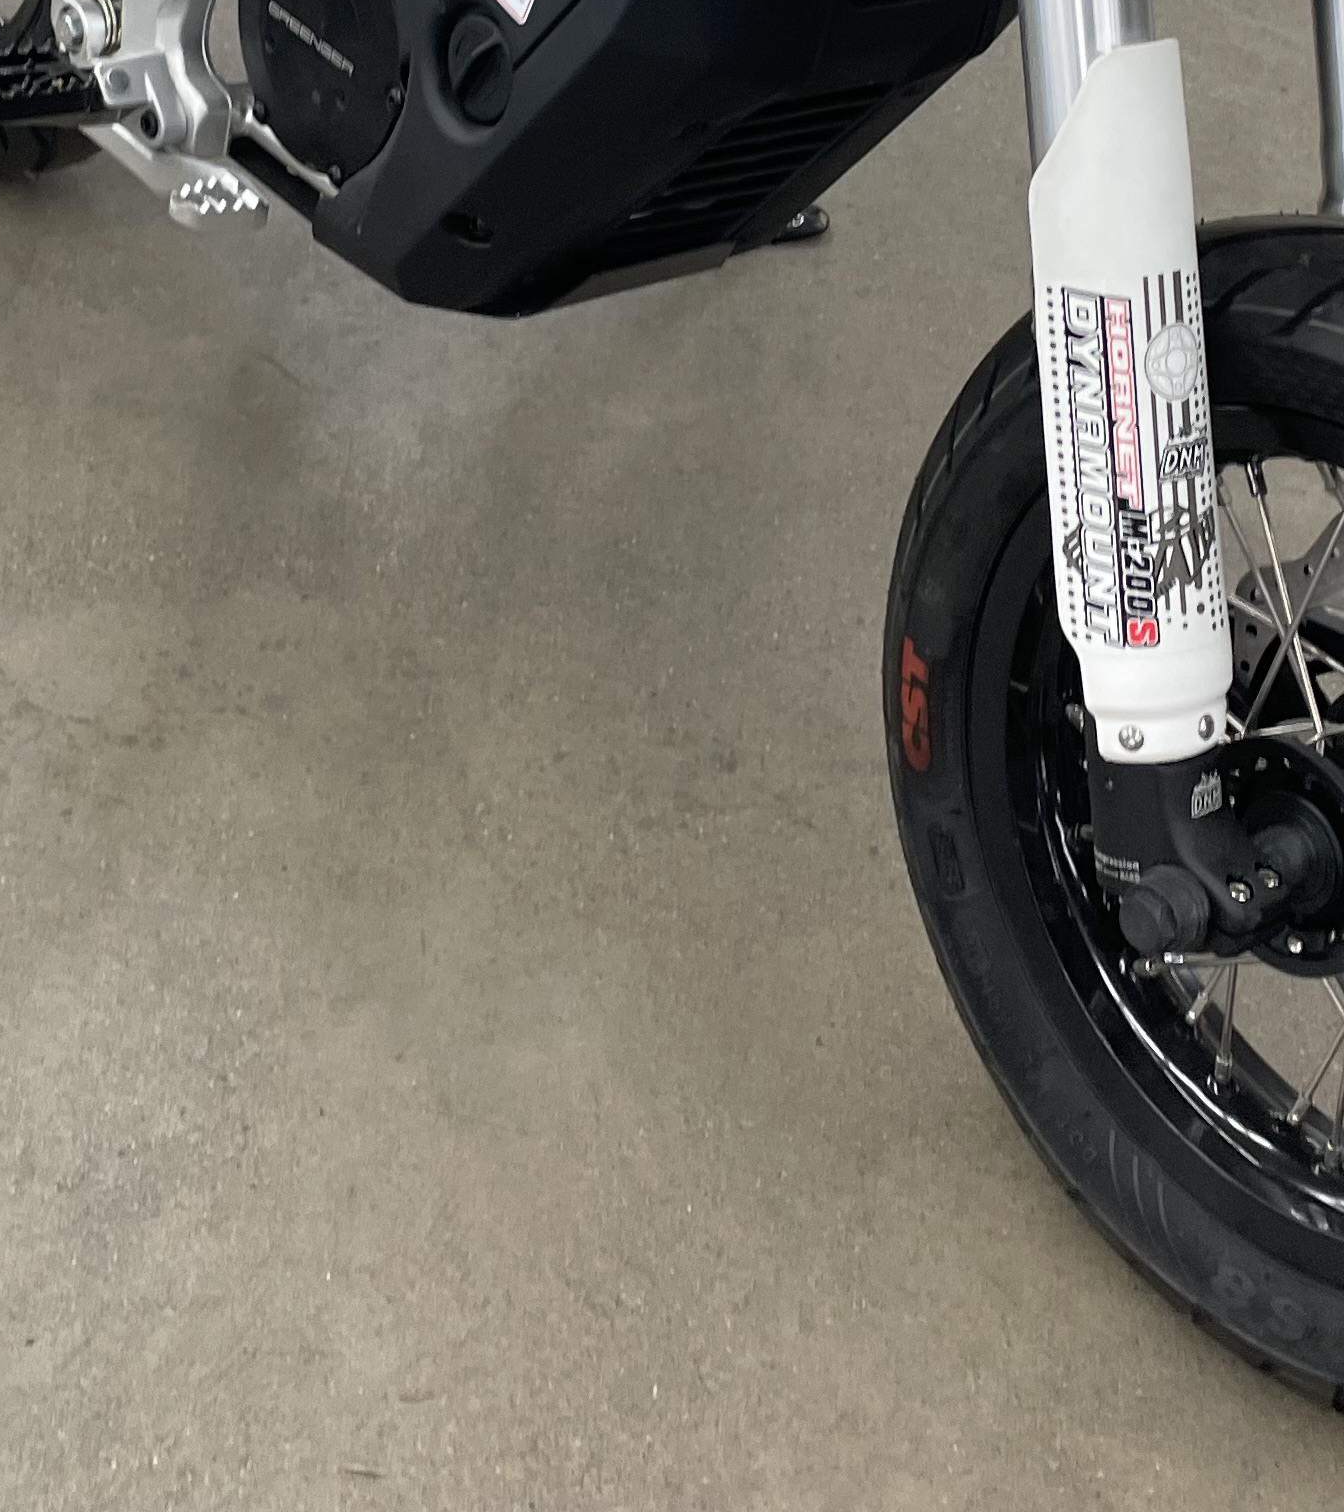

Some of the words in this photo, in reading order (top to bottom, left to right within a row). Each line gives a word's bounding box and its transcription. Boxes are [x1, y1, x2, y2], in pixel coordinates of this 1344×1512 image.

[268, 0, 355, 78] GREENGER
[1063, 288, 1125, 648] DYNAMOUNT
[1105, 297, 1144, 511] HORNET
[1162, 441, 1205, 477] DNM
[899, 635, 931, 772] CST
